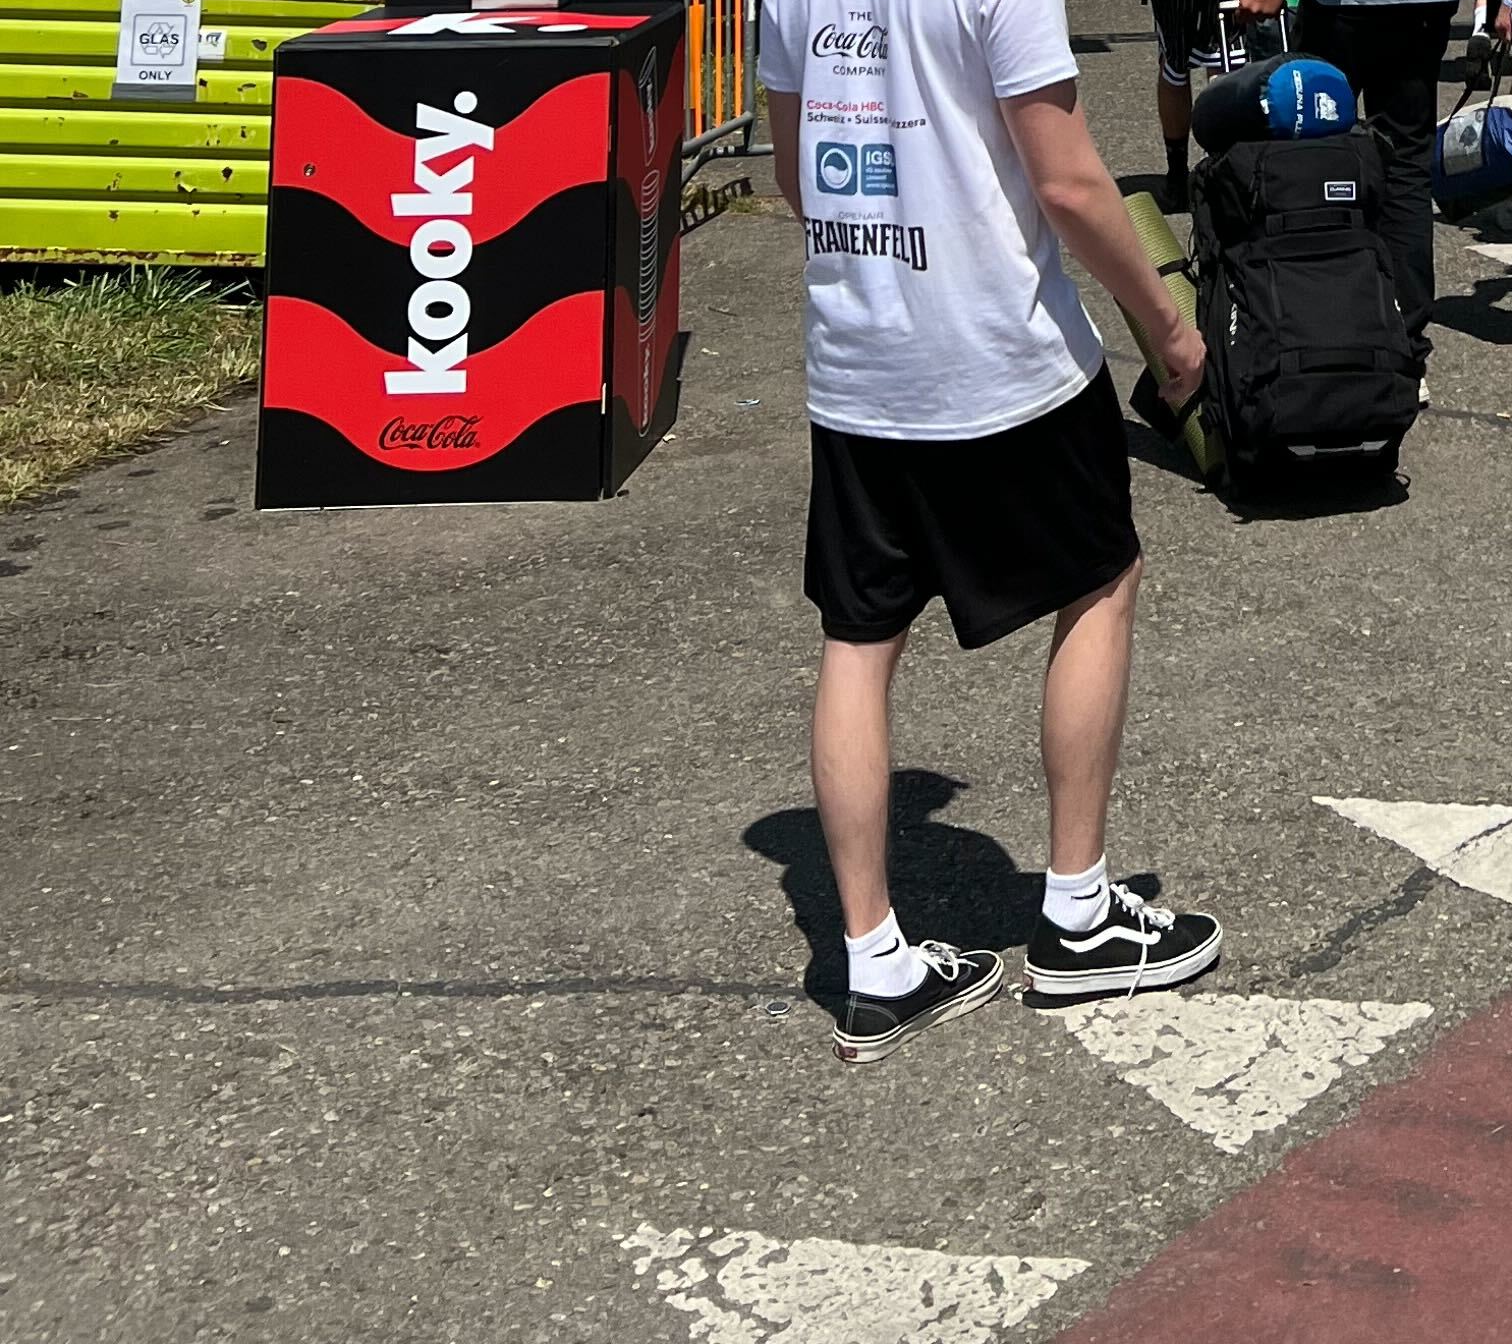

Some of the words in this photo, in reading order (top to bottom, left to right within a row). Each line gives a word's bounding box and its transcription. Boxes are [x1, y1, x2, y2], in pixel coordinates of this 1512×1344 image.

[848, 11, 872, 21] THE
[140, 33, 179, 45] GLAS
[138, 70, 173, 81] ONLY
[833, 65, 886, 76] COMPANY
[807, 100, 858, 112] Coca-Cola
[861, 101, 884, 111] HBC
[807, 112, 845, 123] Schweiz
[384, 91, 495, 395] kooky.
[803, 217, 928, 271] FRAUENFELD
[378, 415, 484, 450] Coca-Cola
